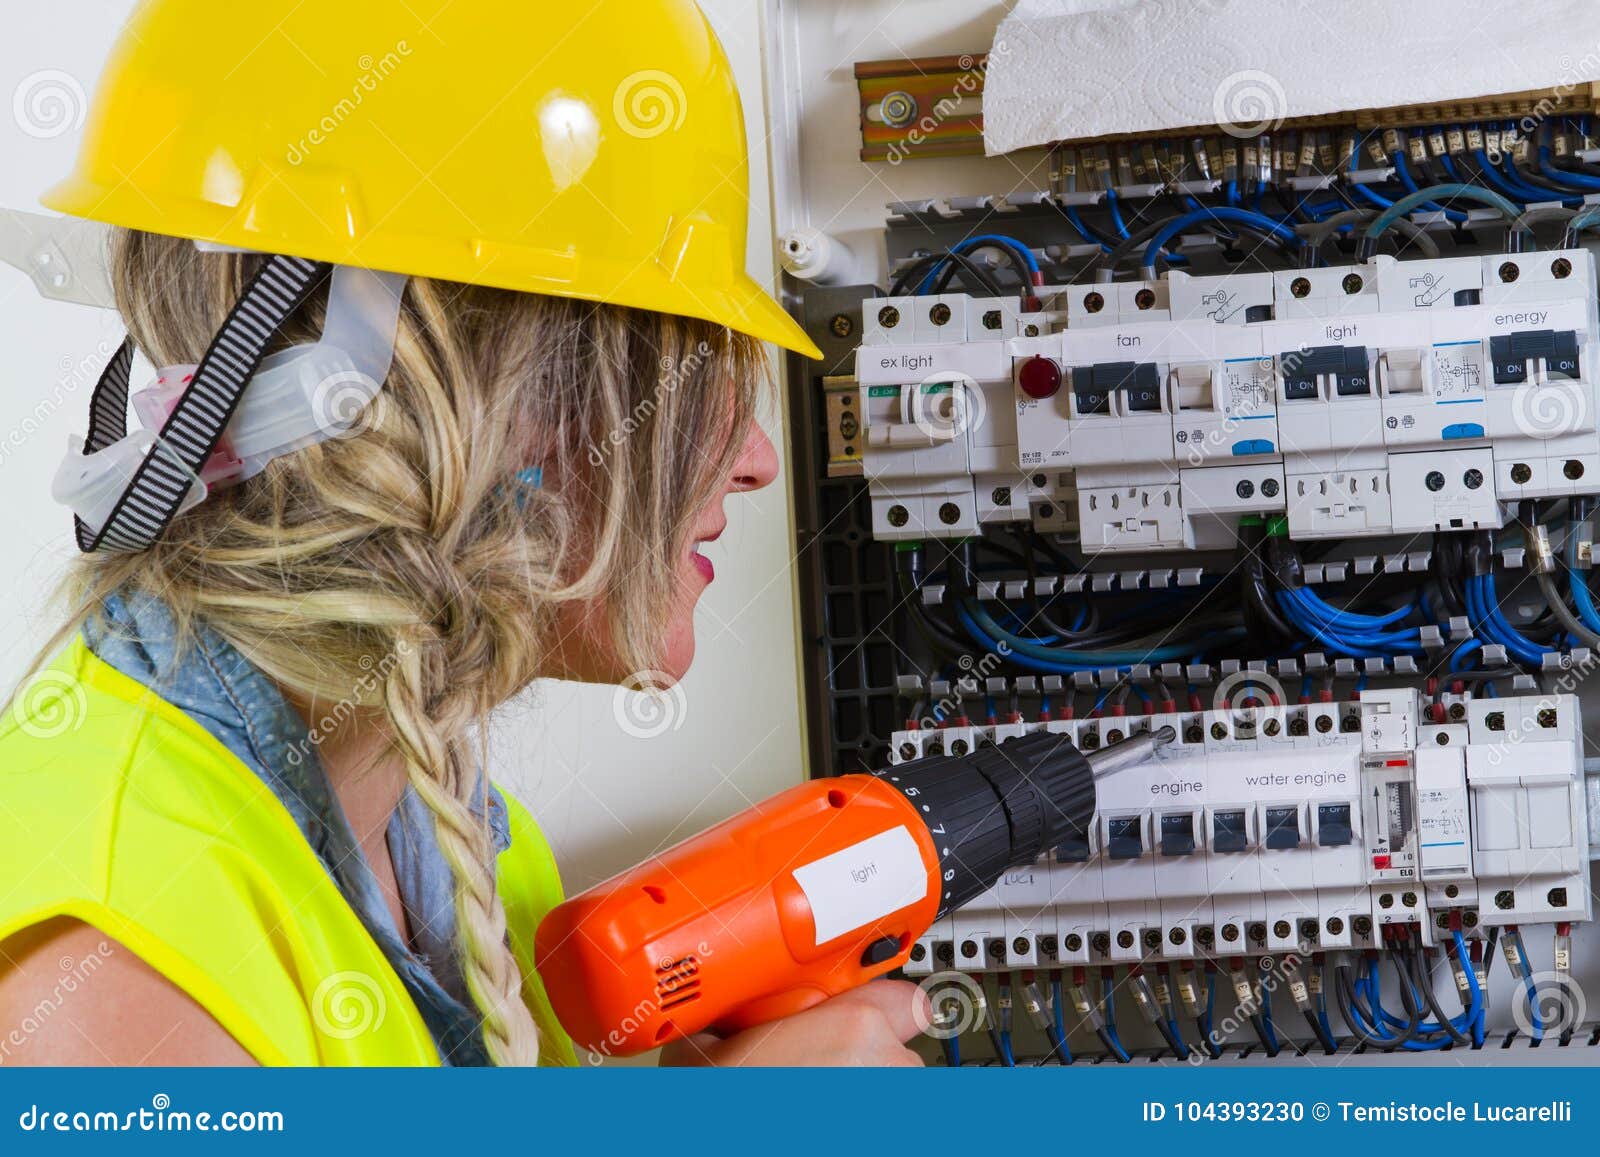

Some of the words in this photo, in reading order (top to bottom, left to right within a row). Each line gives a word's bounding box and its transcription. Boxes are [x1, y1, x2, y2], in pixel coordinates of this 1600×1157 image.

[1495, 312, 1548, 325] energy
[1326, 323, 1357, 339] light
[1117, 334, 1141, 346] fan
[880, 358, 898, 368] ex
[902, 354, 933, 370] light
[1560, 361, 1575, 370] ON
[1507, 364, 1522, 373] ON
[1299, 381, 1314, 390] ON
[1351, 378, 1366, 387] ON
[1141, 391, 1156, 400] ON
[1246, 773, 1290, 785] water
[1294, 771, 1347, 786] engine
[905, 787, 920, 797] 5
[1151, 780, 1203, 795] engine
[933, 823, 945, 834] 7
[851, 863, 878, 883] light
[944, 868, 954, 881] 9
